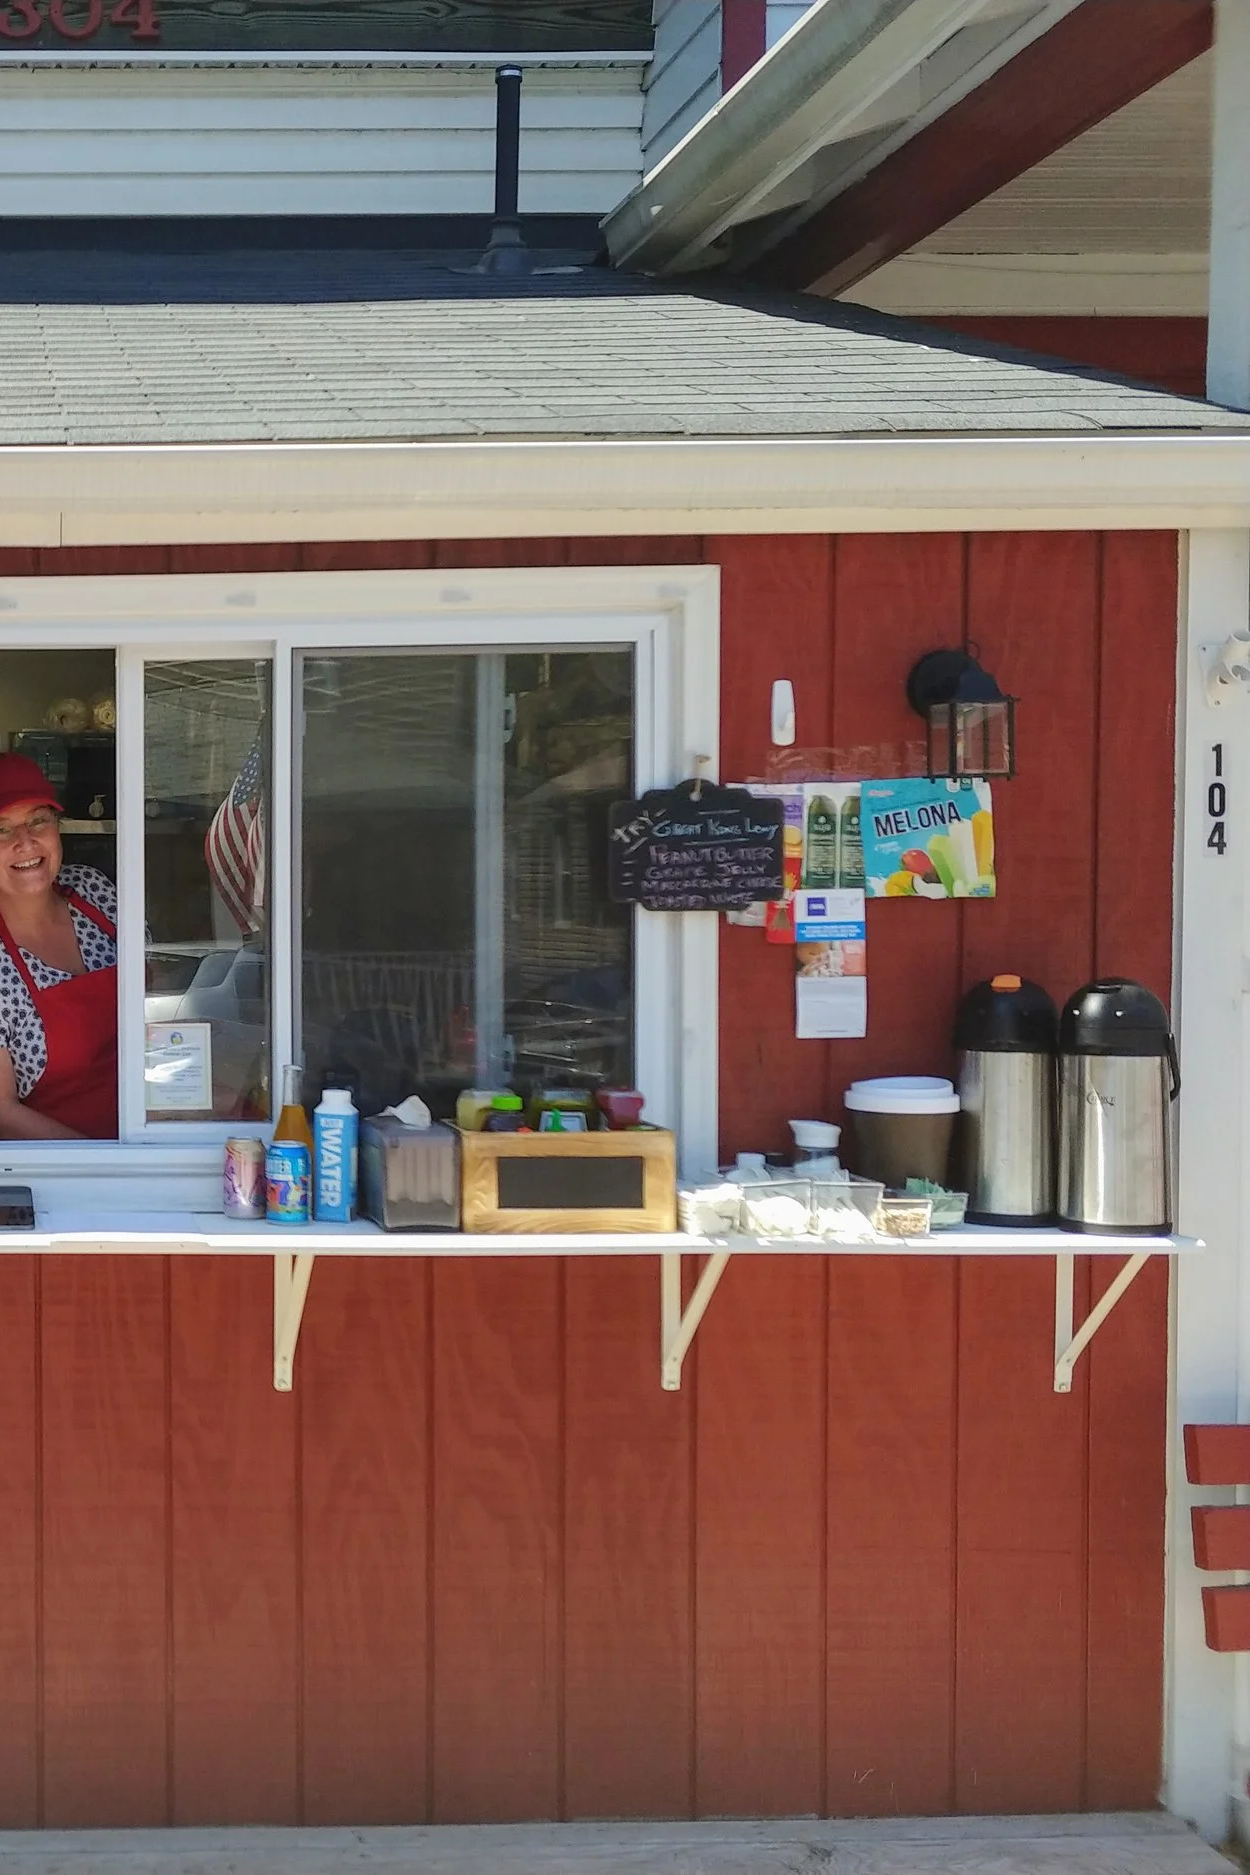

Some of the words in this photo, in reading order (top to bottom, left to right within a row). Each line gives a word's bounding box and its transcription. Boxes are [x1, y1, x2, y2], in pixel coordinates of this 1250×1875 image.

[873, 801, 962, 838] MELONA
[1207, 743, 1227, 856] 104
[320, 1129, 343, 1208] WATER
